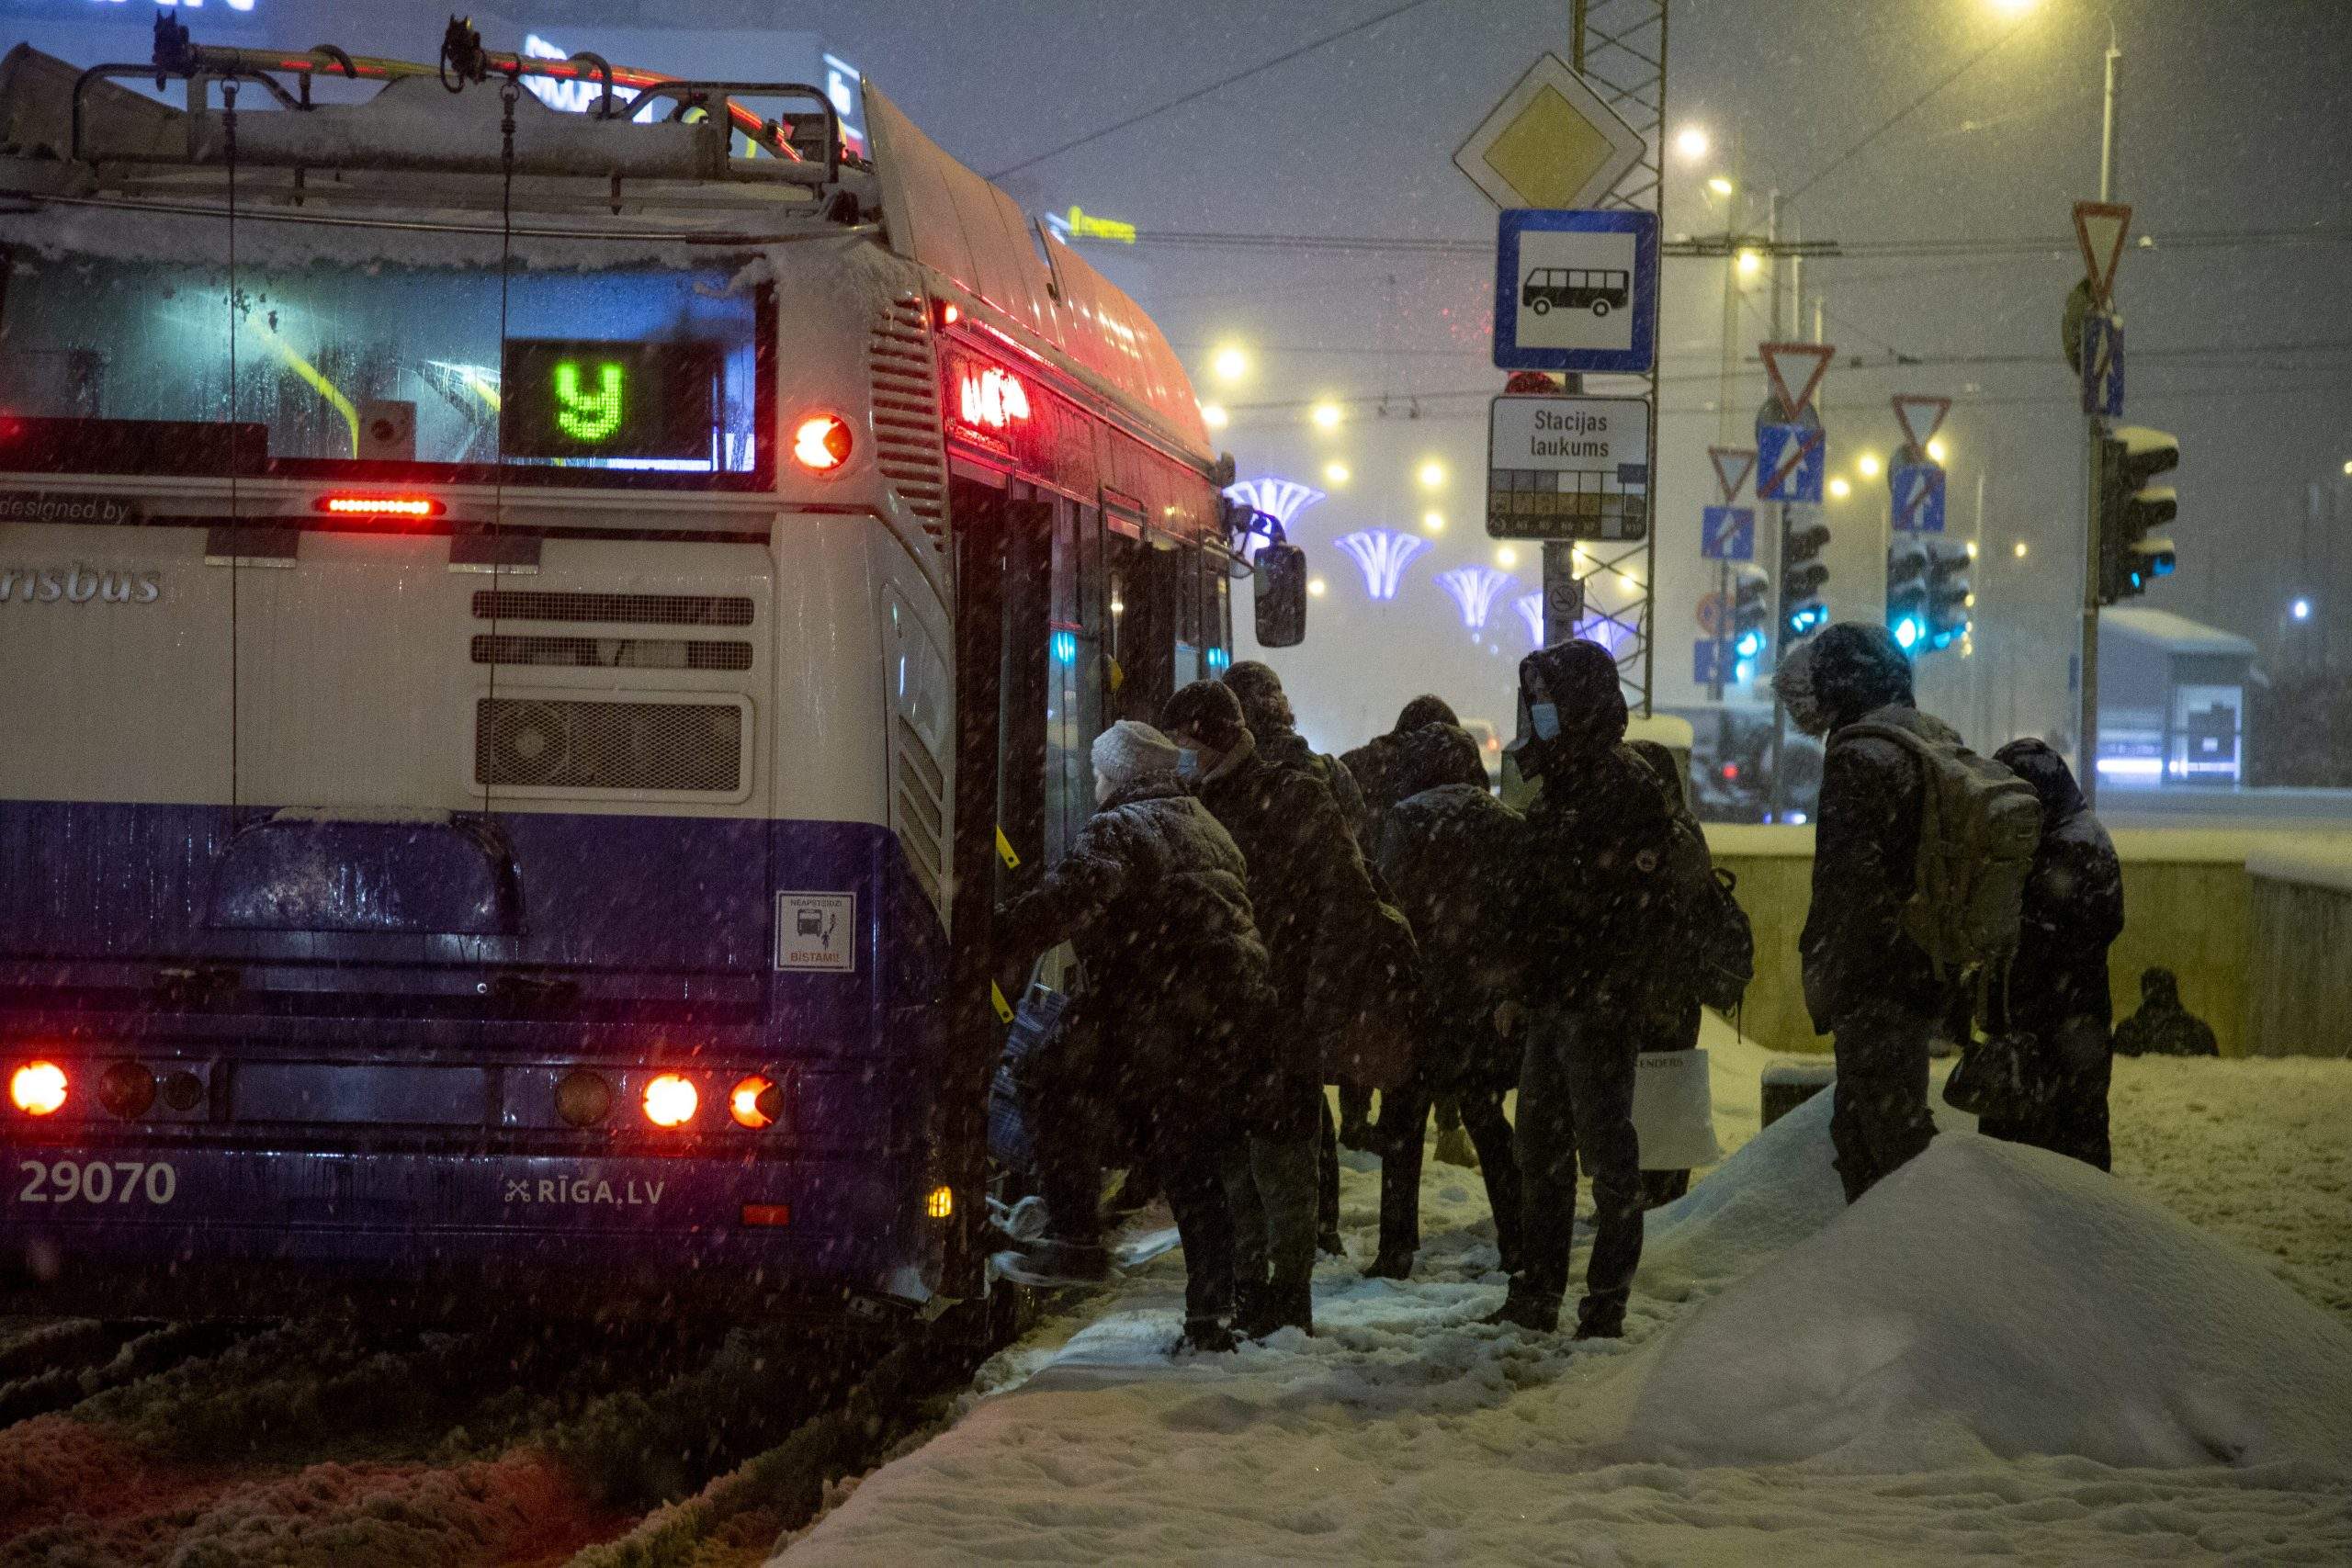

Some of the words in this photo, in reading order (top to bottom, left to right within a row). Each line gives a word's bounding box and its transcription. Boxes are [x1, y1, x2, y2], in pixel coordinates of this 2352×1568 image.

[1534, 410, 1607, 435] Stacijas
[1531, 434, 1609, 457] laukums
[0, 496, 97, 520] designed
[103, 501, 130, 525] by
[19, 1160, 176, 1204] 29070
[538, 1175, 665, 1205] RĪGA.LV
